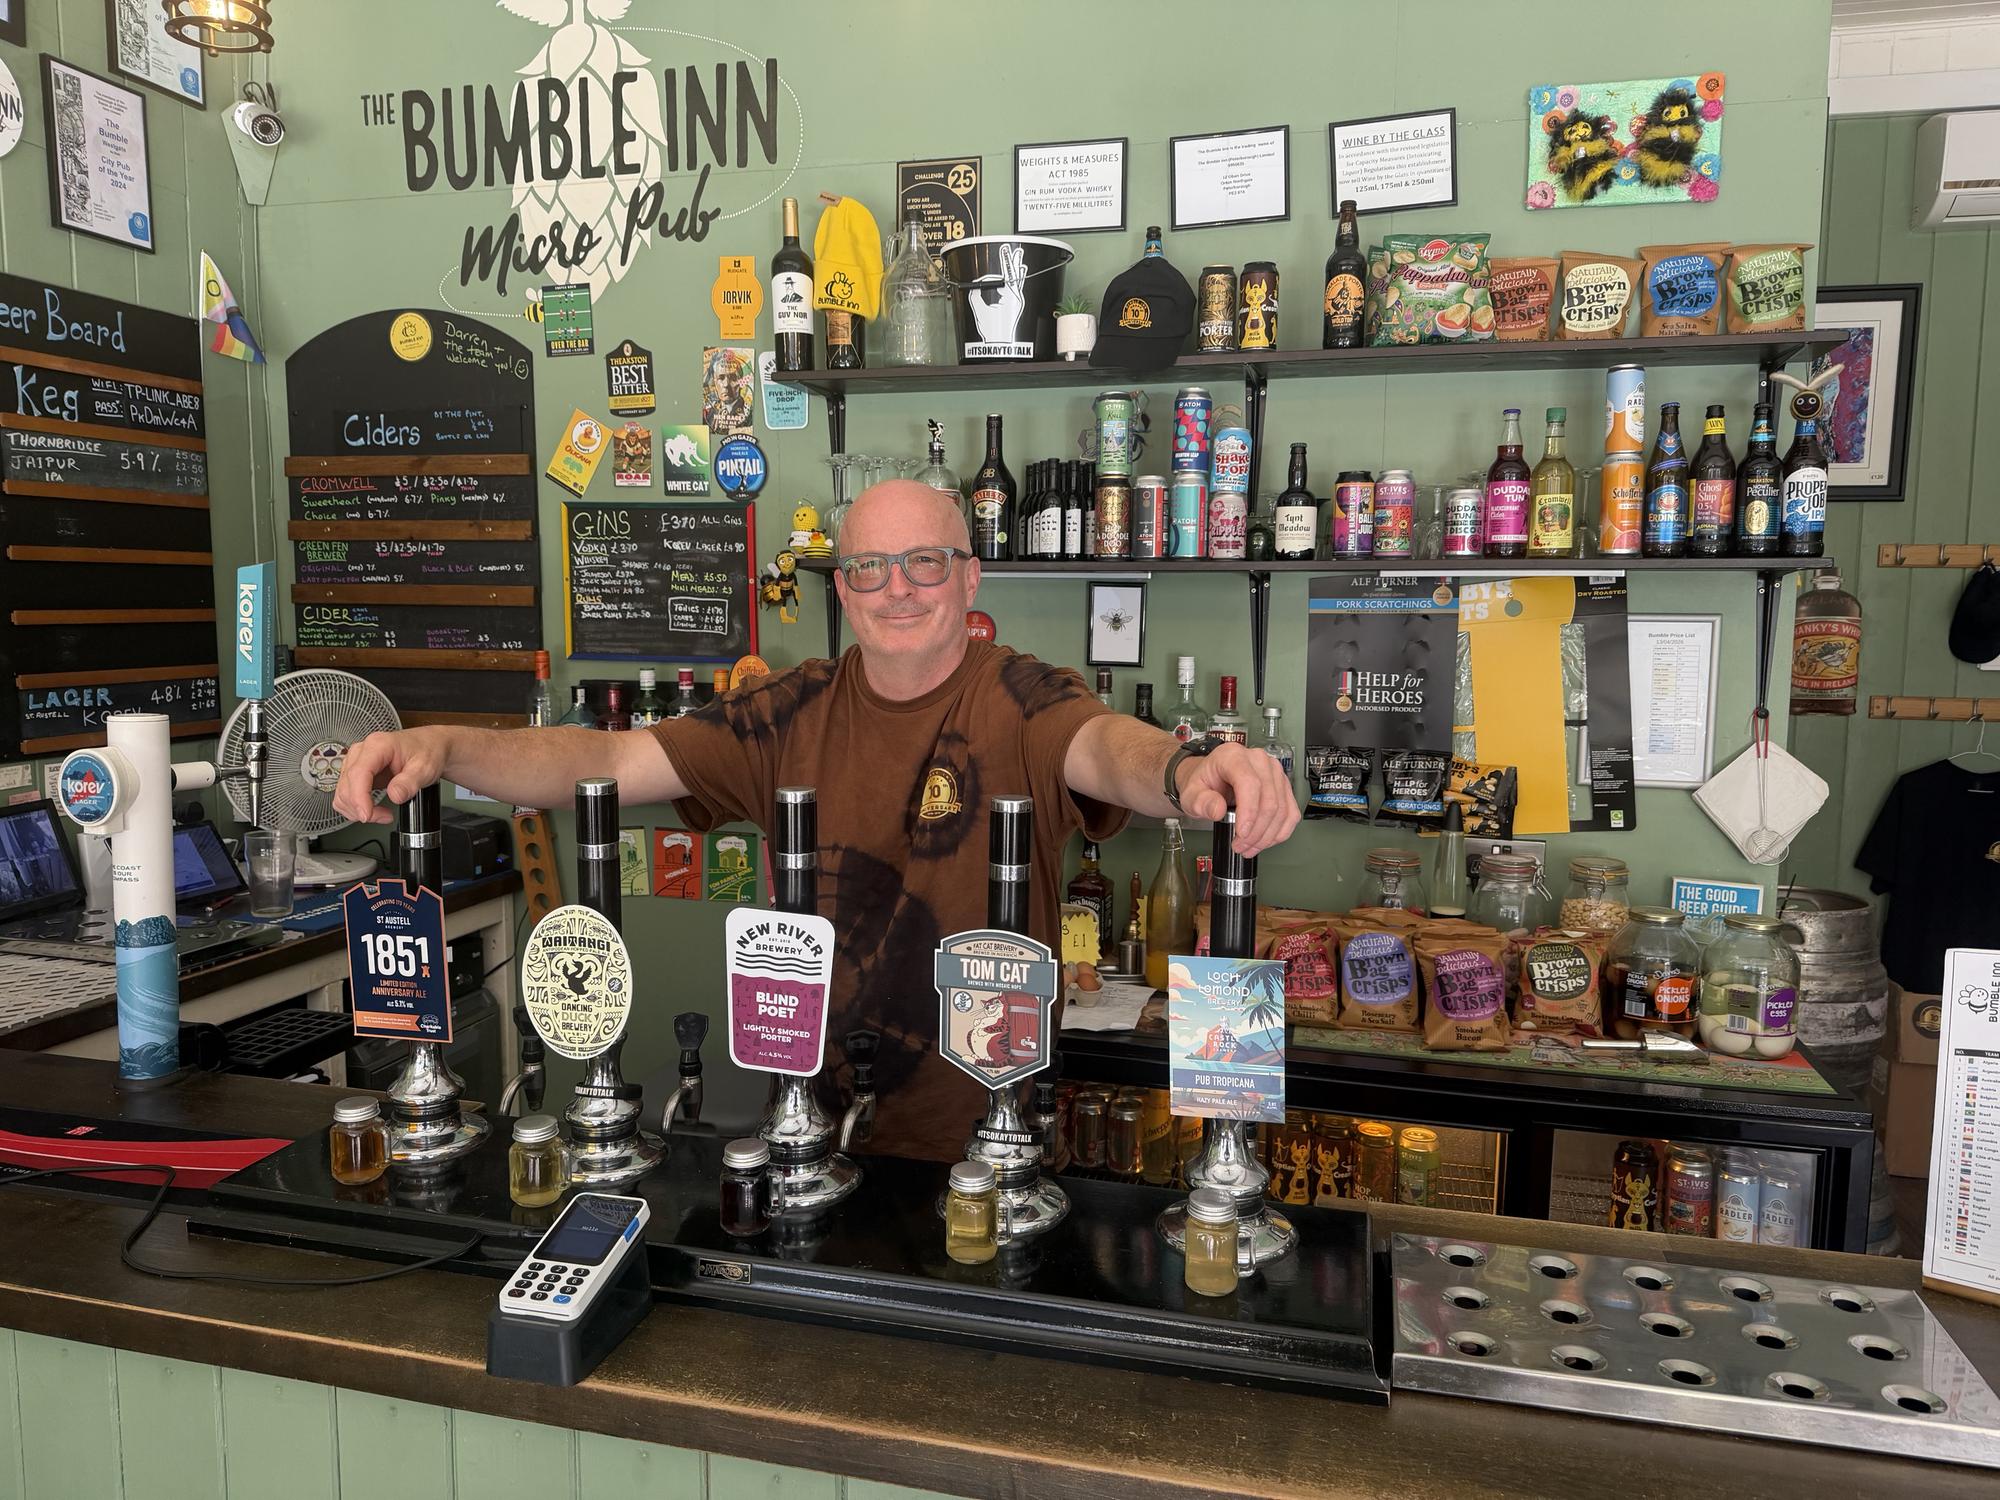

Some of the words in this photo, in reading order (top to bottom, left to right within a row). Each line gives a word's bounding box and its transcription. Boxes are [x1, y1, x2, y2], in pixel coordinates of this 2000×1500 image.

[104, 118, 120, 130] The
[361, 94, 396, 126] THE
[402, 72, 642, 191] BUMBLE
[665, 57, 779, 171] INN
[99, 127, 129, 145] Bumble
[1342, 136, 1369, 148] WINE
[1372, 133, 1386, 144] BY
[1389, 131, 1409, 141] THE
[1412, 126, 1445, 138] GLASS
[101, 155, 115, 169] City
[116, 160, 131, 172] Pub
[1020, 156, 1061, 167] WEIGHTS
[1062, 156, 1068, 164] &
[1071, 153, 1119, 164] MEASURES
[106, 167, 118, 178] the
[119, 171, 135, 183] Year
[951, 169, 973, 189] 25
[1048, 170, 1066, 179] ACT
[1069, 169, 1089, 177] 1985
[110, 179, 127, 190] 2024
[1085, 185, 1112, 193] WHISKY
[1355, 184, 1379, 193] 125ml,
[1381, 181, 1403, 190] 175ml
[1412, 177, 1434, 186] 250ml
[1025, 202, 1071, 210] TWENTY-FIVE
[1072, 200, 1113, 208] MILLILITRES
[461, 213, 602, 297] Micro
[620, 163, 722, 266] Pub
[944, 221, 965, 240] 18
[722, 290, 752, 304] JORVIK
[818, 297, 845, 307] BUMBLE
[1566, 303, 1622, 322] crisps
[44, 288, 126, 352] Board
[443, 320, 488, 347] Darren
[1200, 326, 1233, 337] PORTER
[443, 340, 463, 352] the
[466, 346, 493, 359] team
[551, 340, 565, 349] OVER
[566, 340, 576, 348] THE
[967, 345, 1032, 358] #ITSOKAYTOTALK
[446, 353, 488, 368] welcome
[610, 356, 647, 366] THEAKSTON
[611, 365, 648, 385] BEST
[13, 365, 79, 422] Keg
[612, 383, 650, 395] BITTER
[343, 414, 421, 446] Ciders
[6, 432, 102, 452] THORNBRIDGE
[11, 455, 81, 471] JAIPUR
[718, 459, 763, 477] PINTAIL
[1215, 465, 1228, 474] IT
[45, 472, 64, 482] IPA
[300, 477, 376, 491] CROMWELL
[667, 480, 691, 491] WHITE
[692, 480, 709, 492] CAT
[1699, 483, 1721, 494] Ghost
[972, 489, 1008, 505] BAILEYS
[1746, 486, 1780, 497] Peculier
[301, 495, 361, 508] Sweetheart
[431, 494, 456, 506] Pinky
[1504, 495, 1525, 503] TUN
[1537, 495, 1573, 505] Cromwell
[1698, 492, 1717, 505] Ship
[1802, 495, 1825, 514] JOB
[304, 510, 337, 520] Choice
[701, 516, 720, 524] ALL
[1285, 514, 1304, 523] Tynt
[1649, 513, 1686, 523] ERDINGER
[1811, 511, 1825, 519] IPA
[1278, 523, 1311, 532] Meadow
[299, 542, 329, 551] GREEN
[332, 542, 349, 551] FEN
[573, 541, 608, 553] VODKA
[696, 542, 722, 552] LAGER
[306, 552, 347, 560] BREWERY
[1351, 577, 1371, 587] ALF
[1374, 577, 1418, 587] TURNER
[674, 604, 699, 613] TONICS
[1336, 600, 1360, 609] PORK
[1362, 600, 1432, 609] SCRATCHINGS
[303, 607, 353, 621] CIDER
[239, 583, 257, 663] korev
[1357, 672, 1400, 687] HELP
[1404, 673, 1424, 689] for
[28, 687, 114, 710] LAGER
[1356, 688, 1423, 705] HEROES
[36, 711, 70, 719] AUSTELL
[1404, 760, 1445, 770] TURNER
[67, 776, 105, 794] korev
[1393, 788, 1428, 796] HEROES
[1680, 886, 1702, 901] THE
[1705, 887, 1738, 902] GOOD
[1679, 901, 1708, 914] BEER
[385, 916, 411, 925] AUSTELL
[542, 936, 611, 952] WAITANGI
[736, 922, 770, 949] NEW
[777, 922, 823, 958] RIVER
[756, 943, 803, 955] BREWERY
[994, 943, 1017, 952] BREWERY
[361, 934, 430, 977] 1851
[960, 959, 995, 981] TOM
[1000, 961, 1030, 984] CAT
[1207, 972, 1241, 984] LOCH
[1199, 984, 1250, 997] LOMOND
[1534, 975, 1588, 993] crisps
[372, 986, 415, 997] ANNIVERSARY
[415, 990, 427, 998] ALE
[1656, 993, 1690, 1004] ONIONS
[756, 991, 799, 1007] BLIND
[1989, 980, 2000, 1023] BUMBLE
[562, 1003, 593, 1013] DANCING
[758, 1005, 796, 1019] POET
[561, 1012, 592, 1022] DUCK
[562, 1022, 593, 1032] BREWERY
[743, 1024, 775, 1033] LIGHTLY
[777, 1028, 811, 1038] SMOKED
[1455, 1026, 1483, 1034] Smoked
[761, 1033, 792, 1043] PORTER
[1456, 1033, 1481, 1041] Bacon
[1213, 1041, 1237, 1049] ROCK
[1196, 1075, 1211, 1085] PUB
[1213, 1076, 1255, 1089] TROPICANA
[1196, 1096, 1211, 1104] HAZY
[977, 1129, 1032, 1143] #ITSOKAYTOTALK
[1720, 1208, 1753, 1221] RADLER
